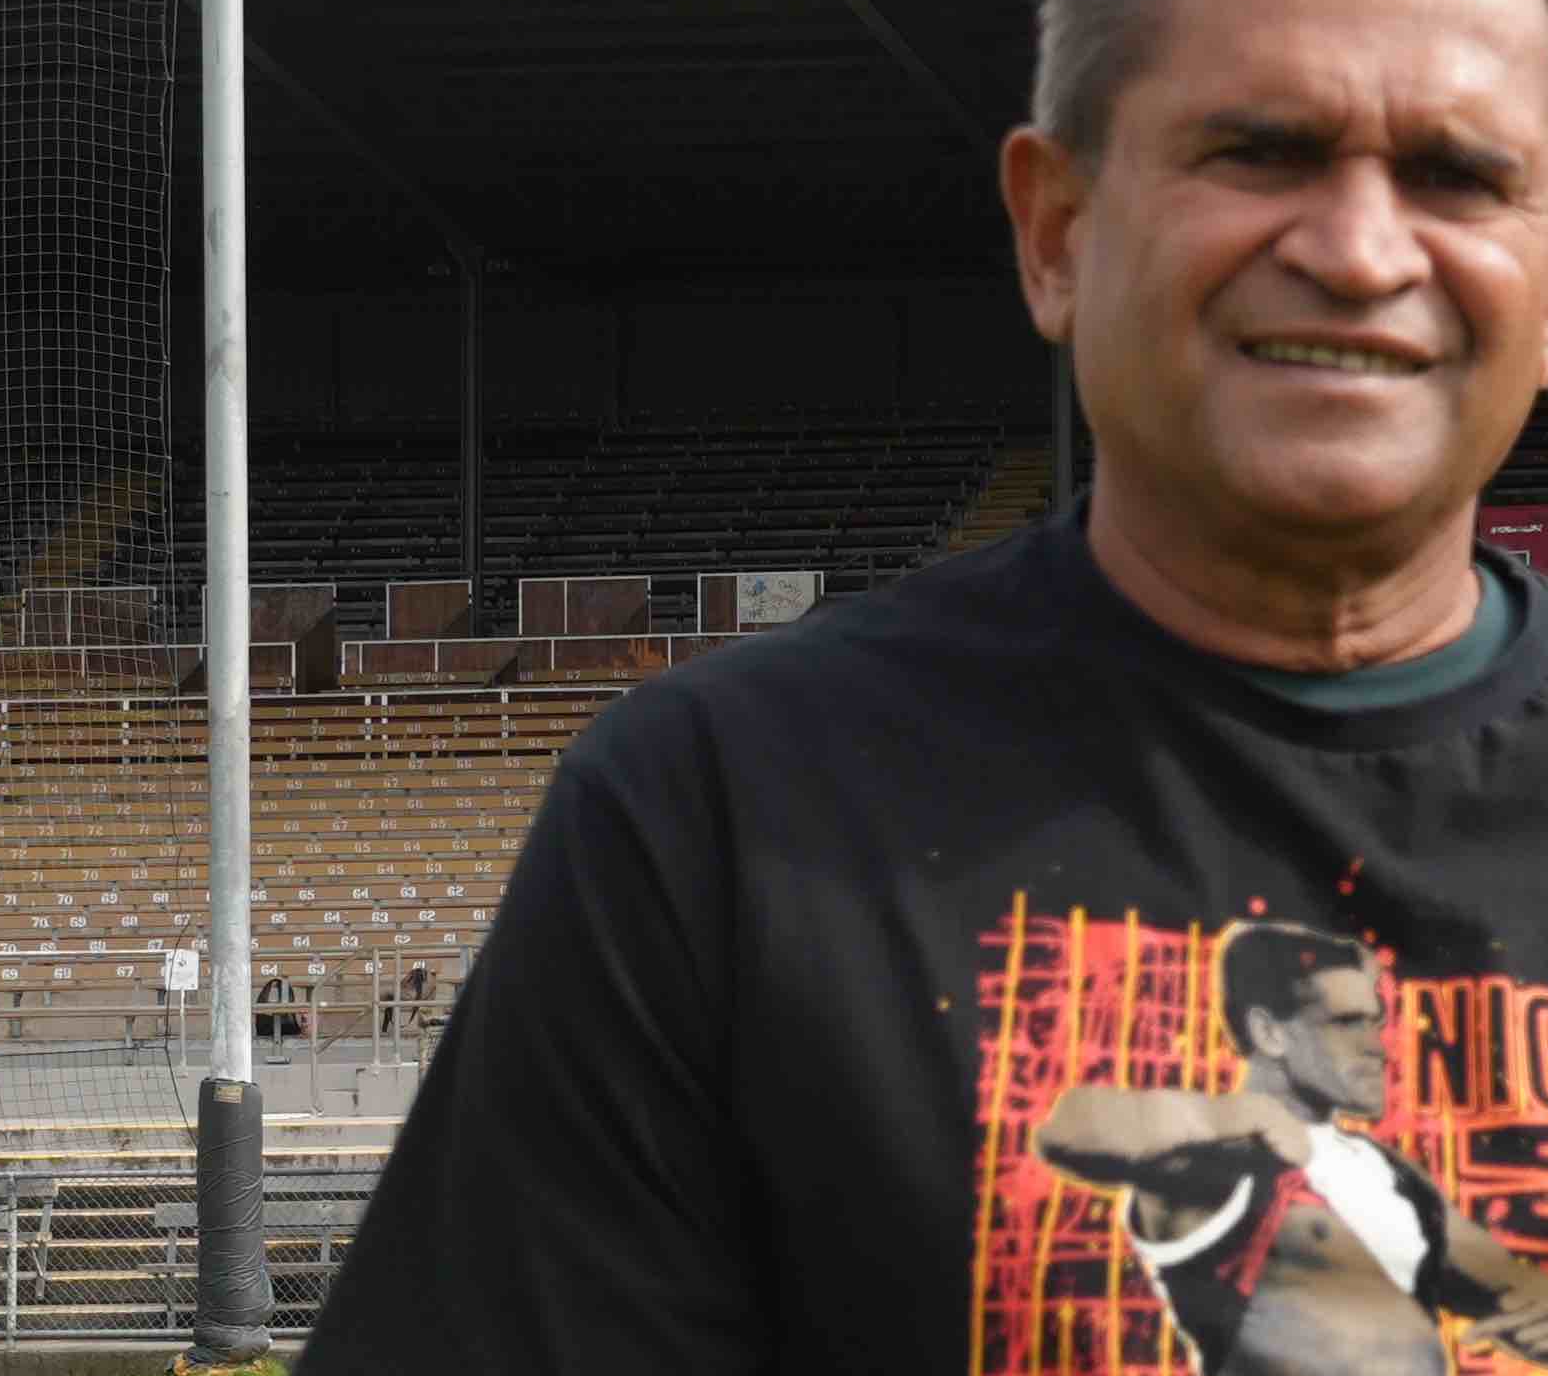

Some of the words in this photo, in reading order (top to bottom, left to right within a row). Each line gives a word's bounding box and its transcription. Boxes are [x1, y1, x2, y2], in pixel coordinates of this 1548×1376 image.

[3, 894, 17, 905] 71
[57, 893, 73, 905] 70
[100, 892, 118, 904] 69
[298, 889, 315, 901] 65
[352, 887, 369, 900] 64
[400, 886, 417, 898] 63
[446, 885, 464, 897] 62
[270, 912, 287, 924] 65
[323, 911, 341, 923] 64
[371, 911, 389, 923] 63
[418, 910, 436, 922] 62
[1, 968, 19, 980] 69
[116, 965, 135, 977] 67
[260, 964, 278, 977] 64
[307, 963, 326, 975] 63
